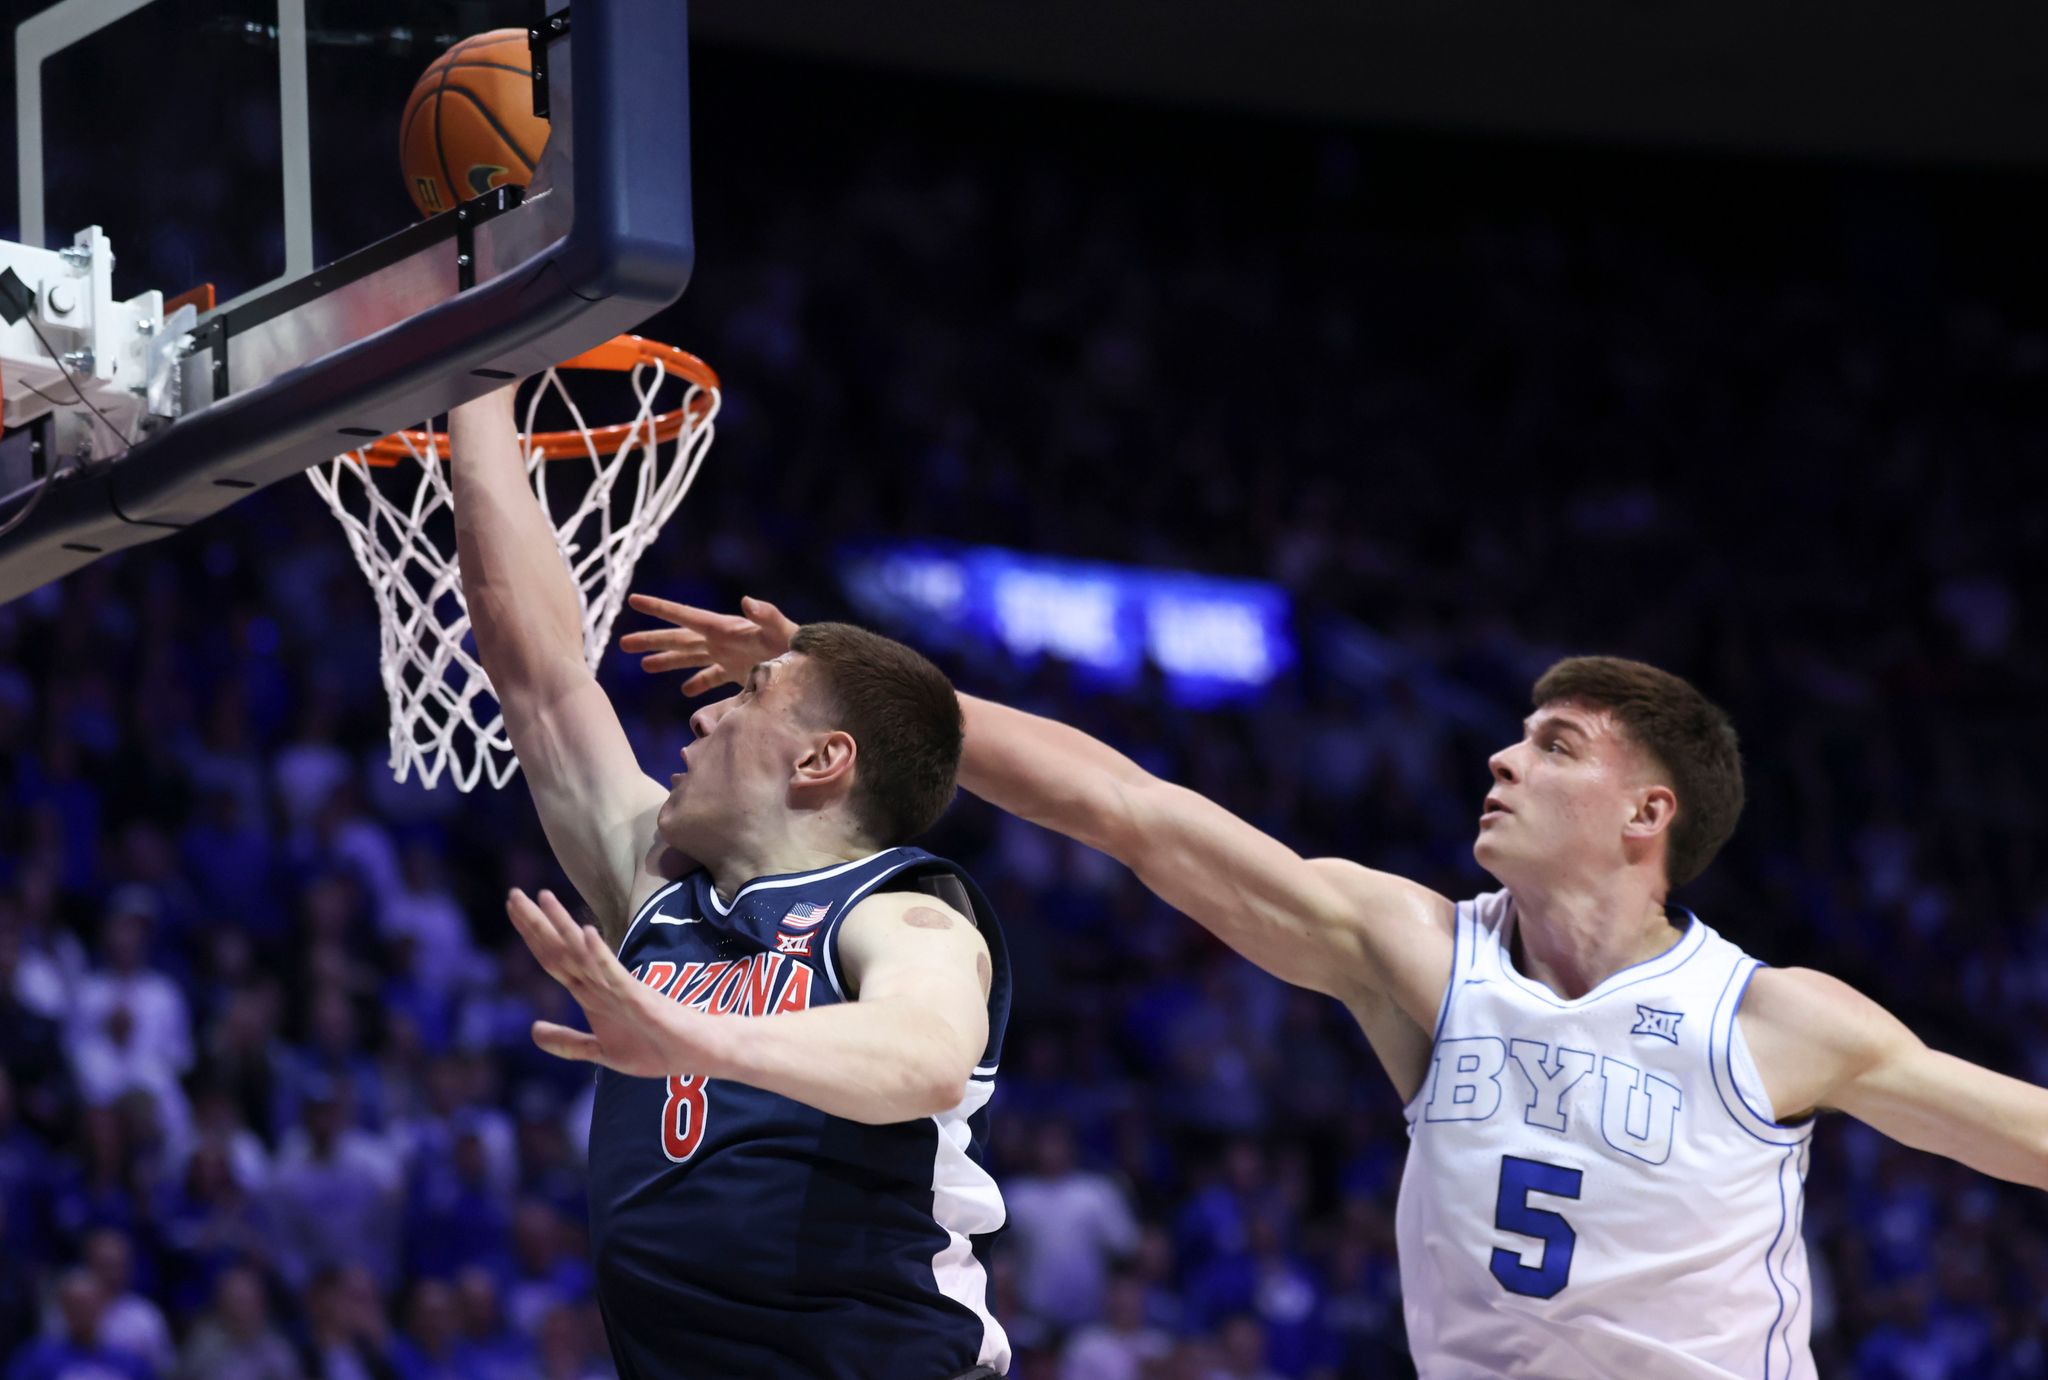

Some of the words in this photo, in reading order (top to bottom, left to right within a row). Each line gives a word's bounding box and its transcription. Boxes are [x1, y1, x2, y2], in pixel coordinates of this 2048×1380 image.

[628, 950, 813, 1018] RIZONA
[661, 1075, 708, 1163] 8
[1425, 1036, 1682, 1166] BYU
[1489, 1154, 1583, 1300] 5
